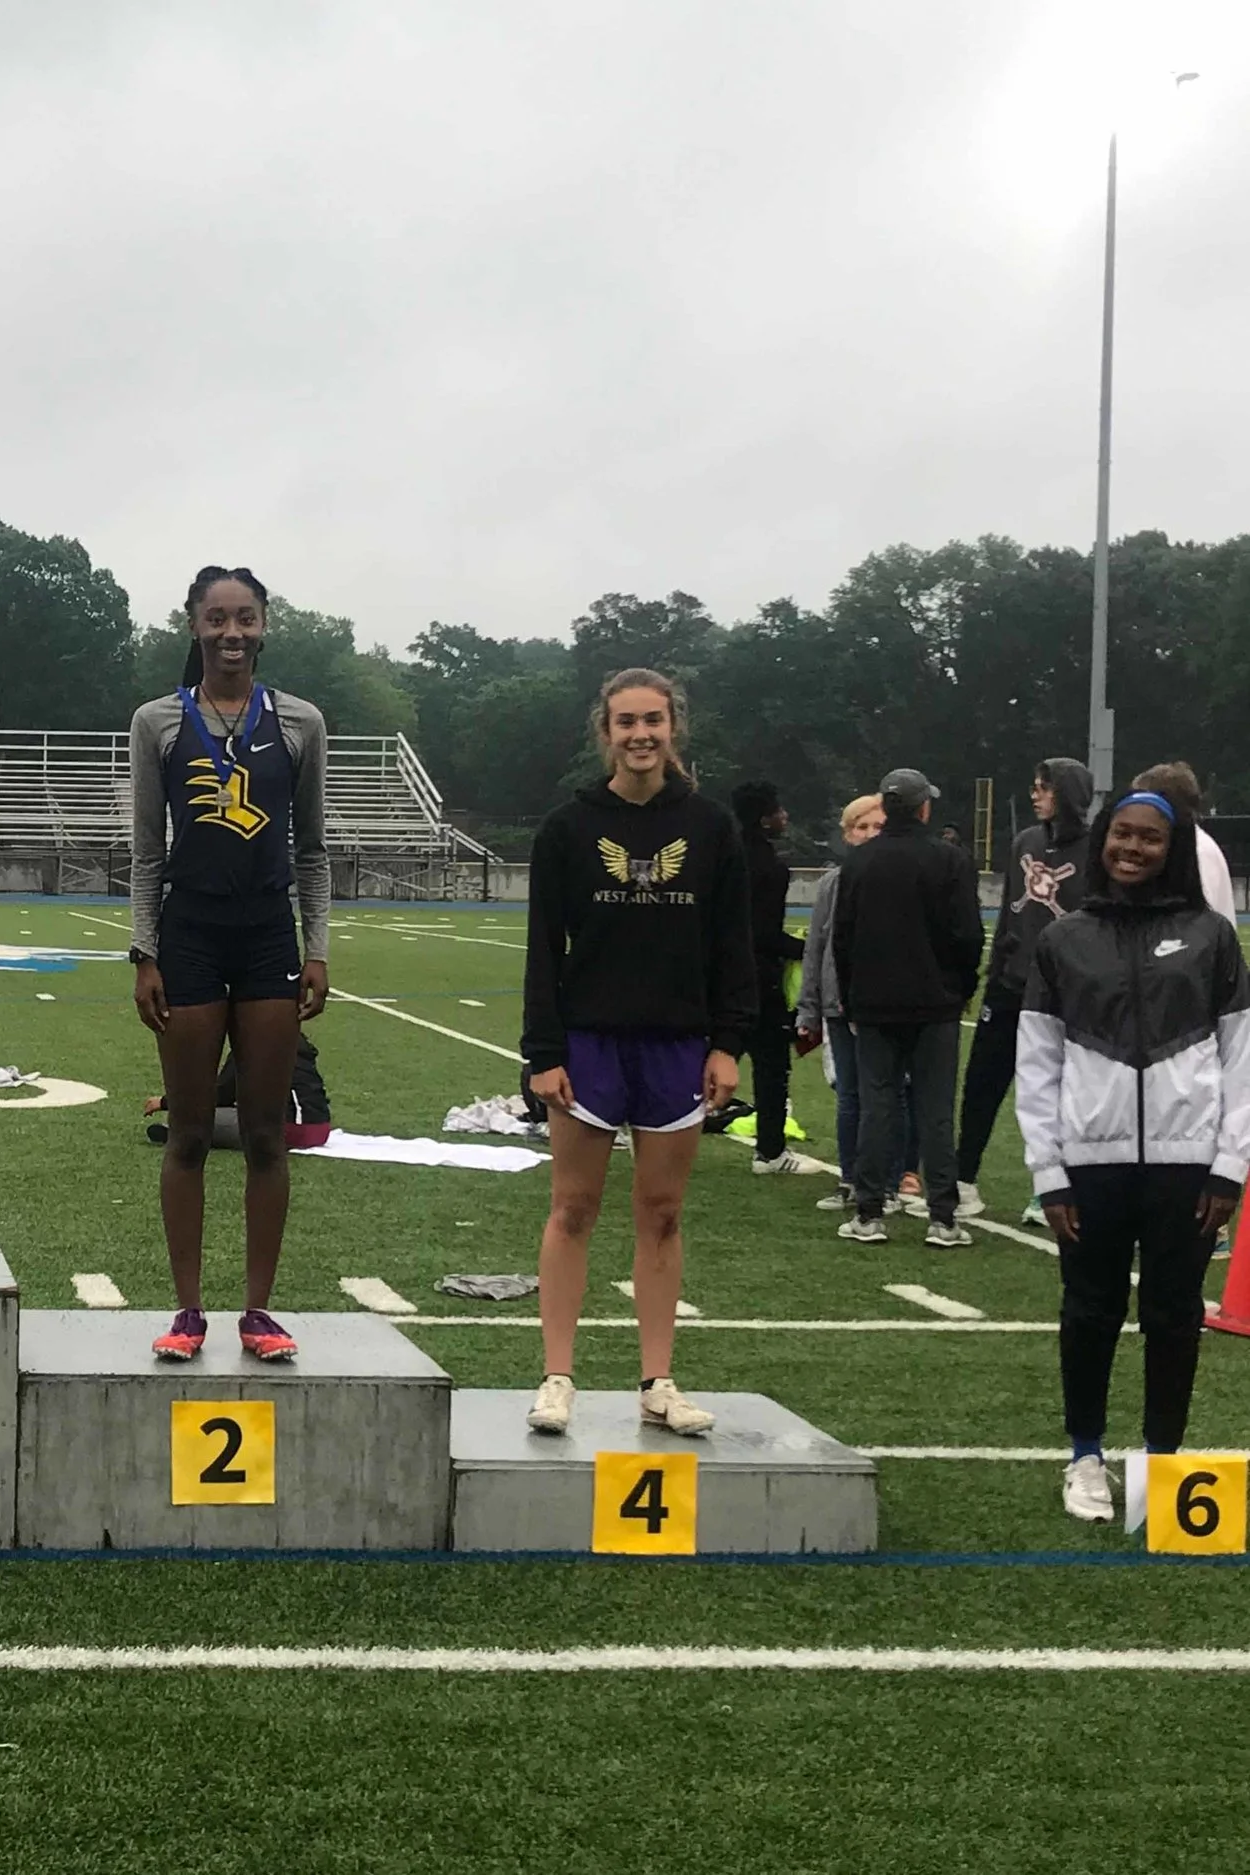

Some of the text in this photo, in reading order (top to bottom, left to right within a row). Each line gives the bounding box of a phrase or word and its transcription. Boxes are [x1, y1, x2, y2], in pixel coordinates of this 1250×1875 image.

[592, 890, 695, 905] WESTMINTER
[200, 1417, 246, 1483] 2
[620, 1469, 669, 1534] 4
[1176, 1471, 1220, 1538] 6
